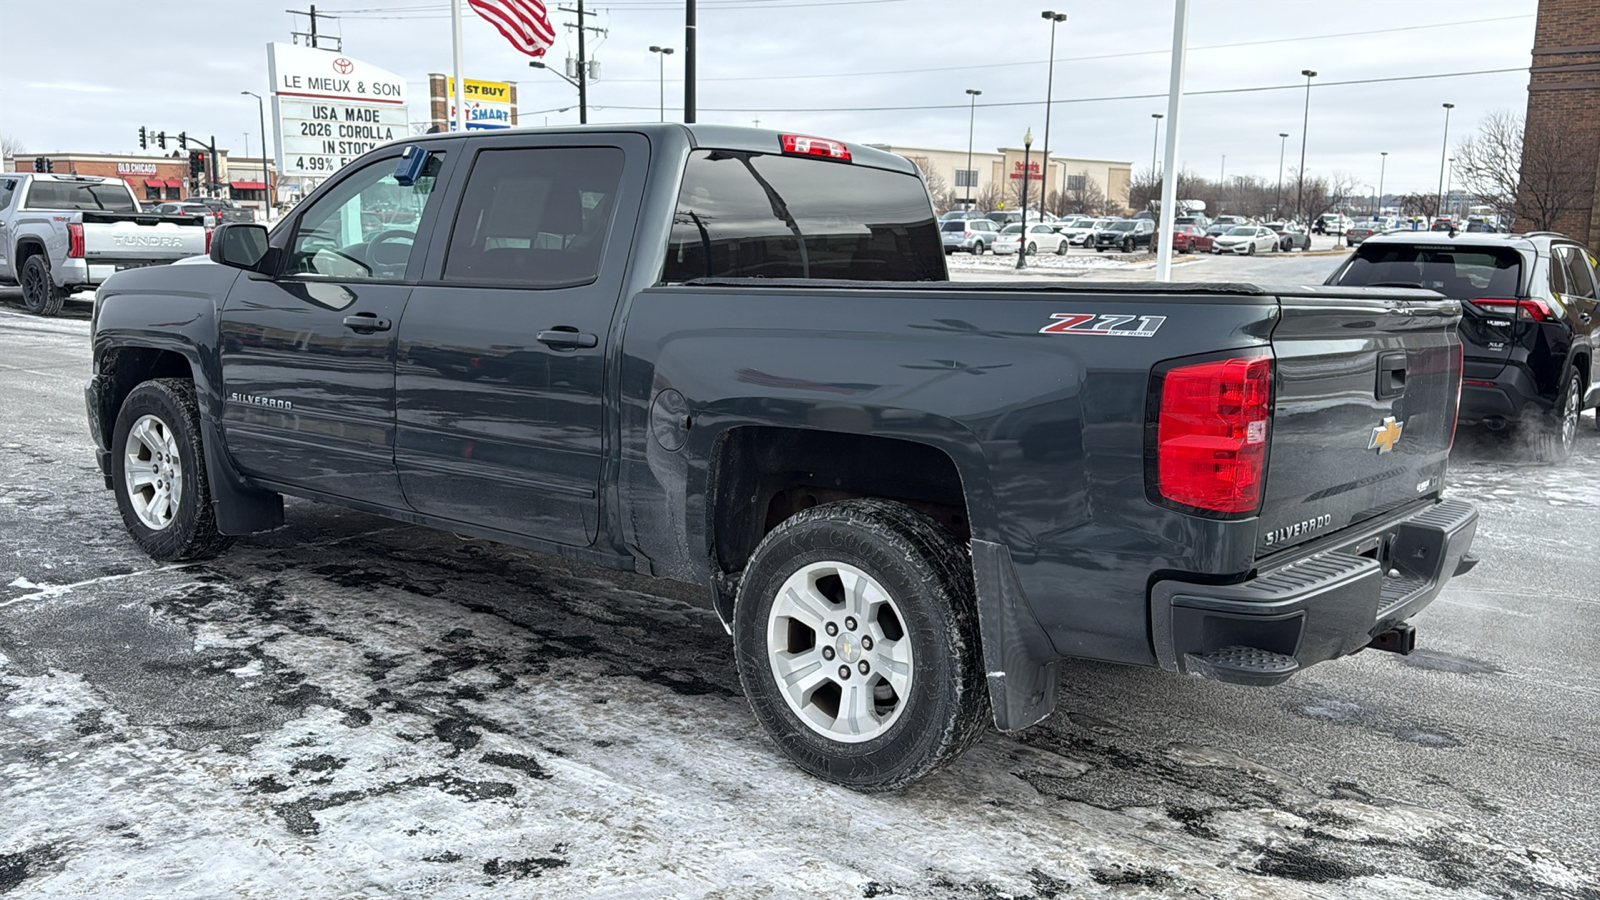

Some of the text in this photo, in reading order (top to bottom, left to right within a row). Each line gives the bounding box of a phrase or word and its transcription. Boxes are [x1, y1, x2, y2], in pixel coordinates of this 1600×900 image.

[284, 75, 401, 96] LE MIEUX & SON
[453, 82, 505, 97] EST BUY
[312, 105, 380, 123] USA MADE
[451, 105, 508, 122] PTSMART
[301, 122, 393, 140] 2026 COROLLA
[322, 140, 335, 154] IN
[118, 163, 130, 172] OLD
[131, 163, 156, 173] CHICAGO
[296, 156, 334, 171] 4.99%
[112, 235, 183, 247] TUNDRA
[1038, 312, 1167, 338] Z71
[232, 392, 292, 410] SILVERADO
[1265, 513, 1332, 546] SILVERADO
